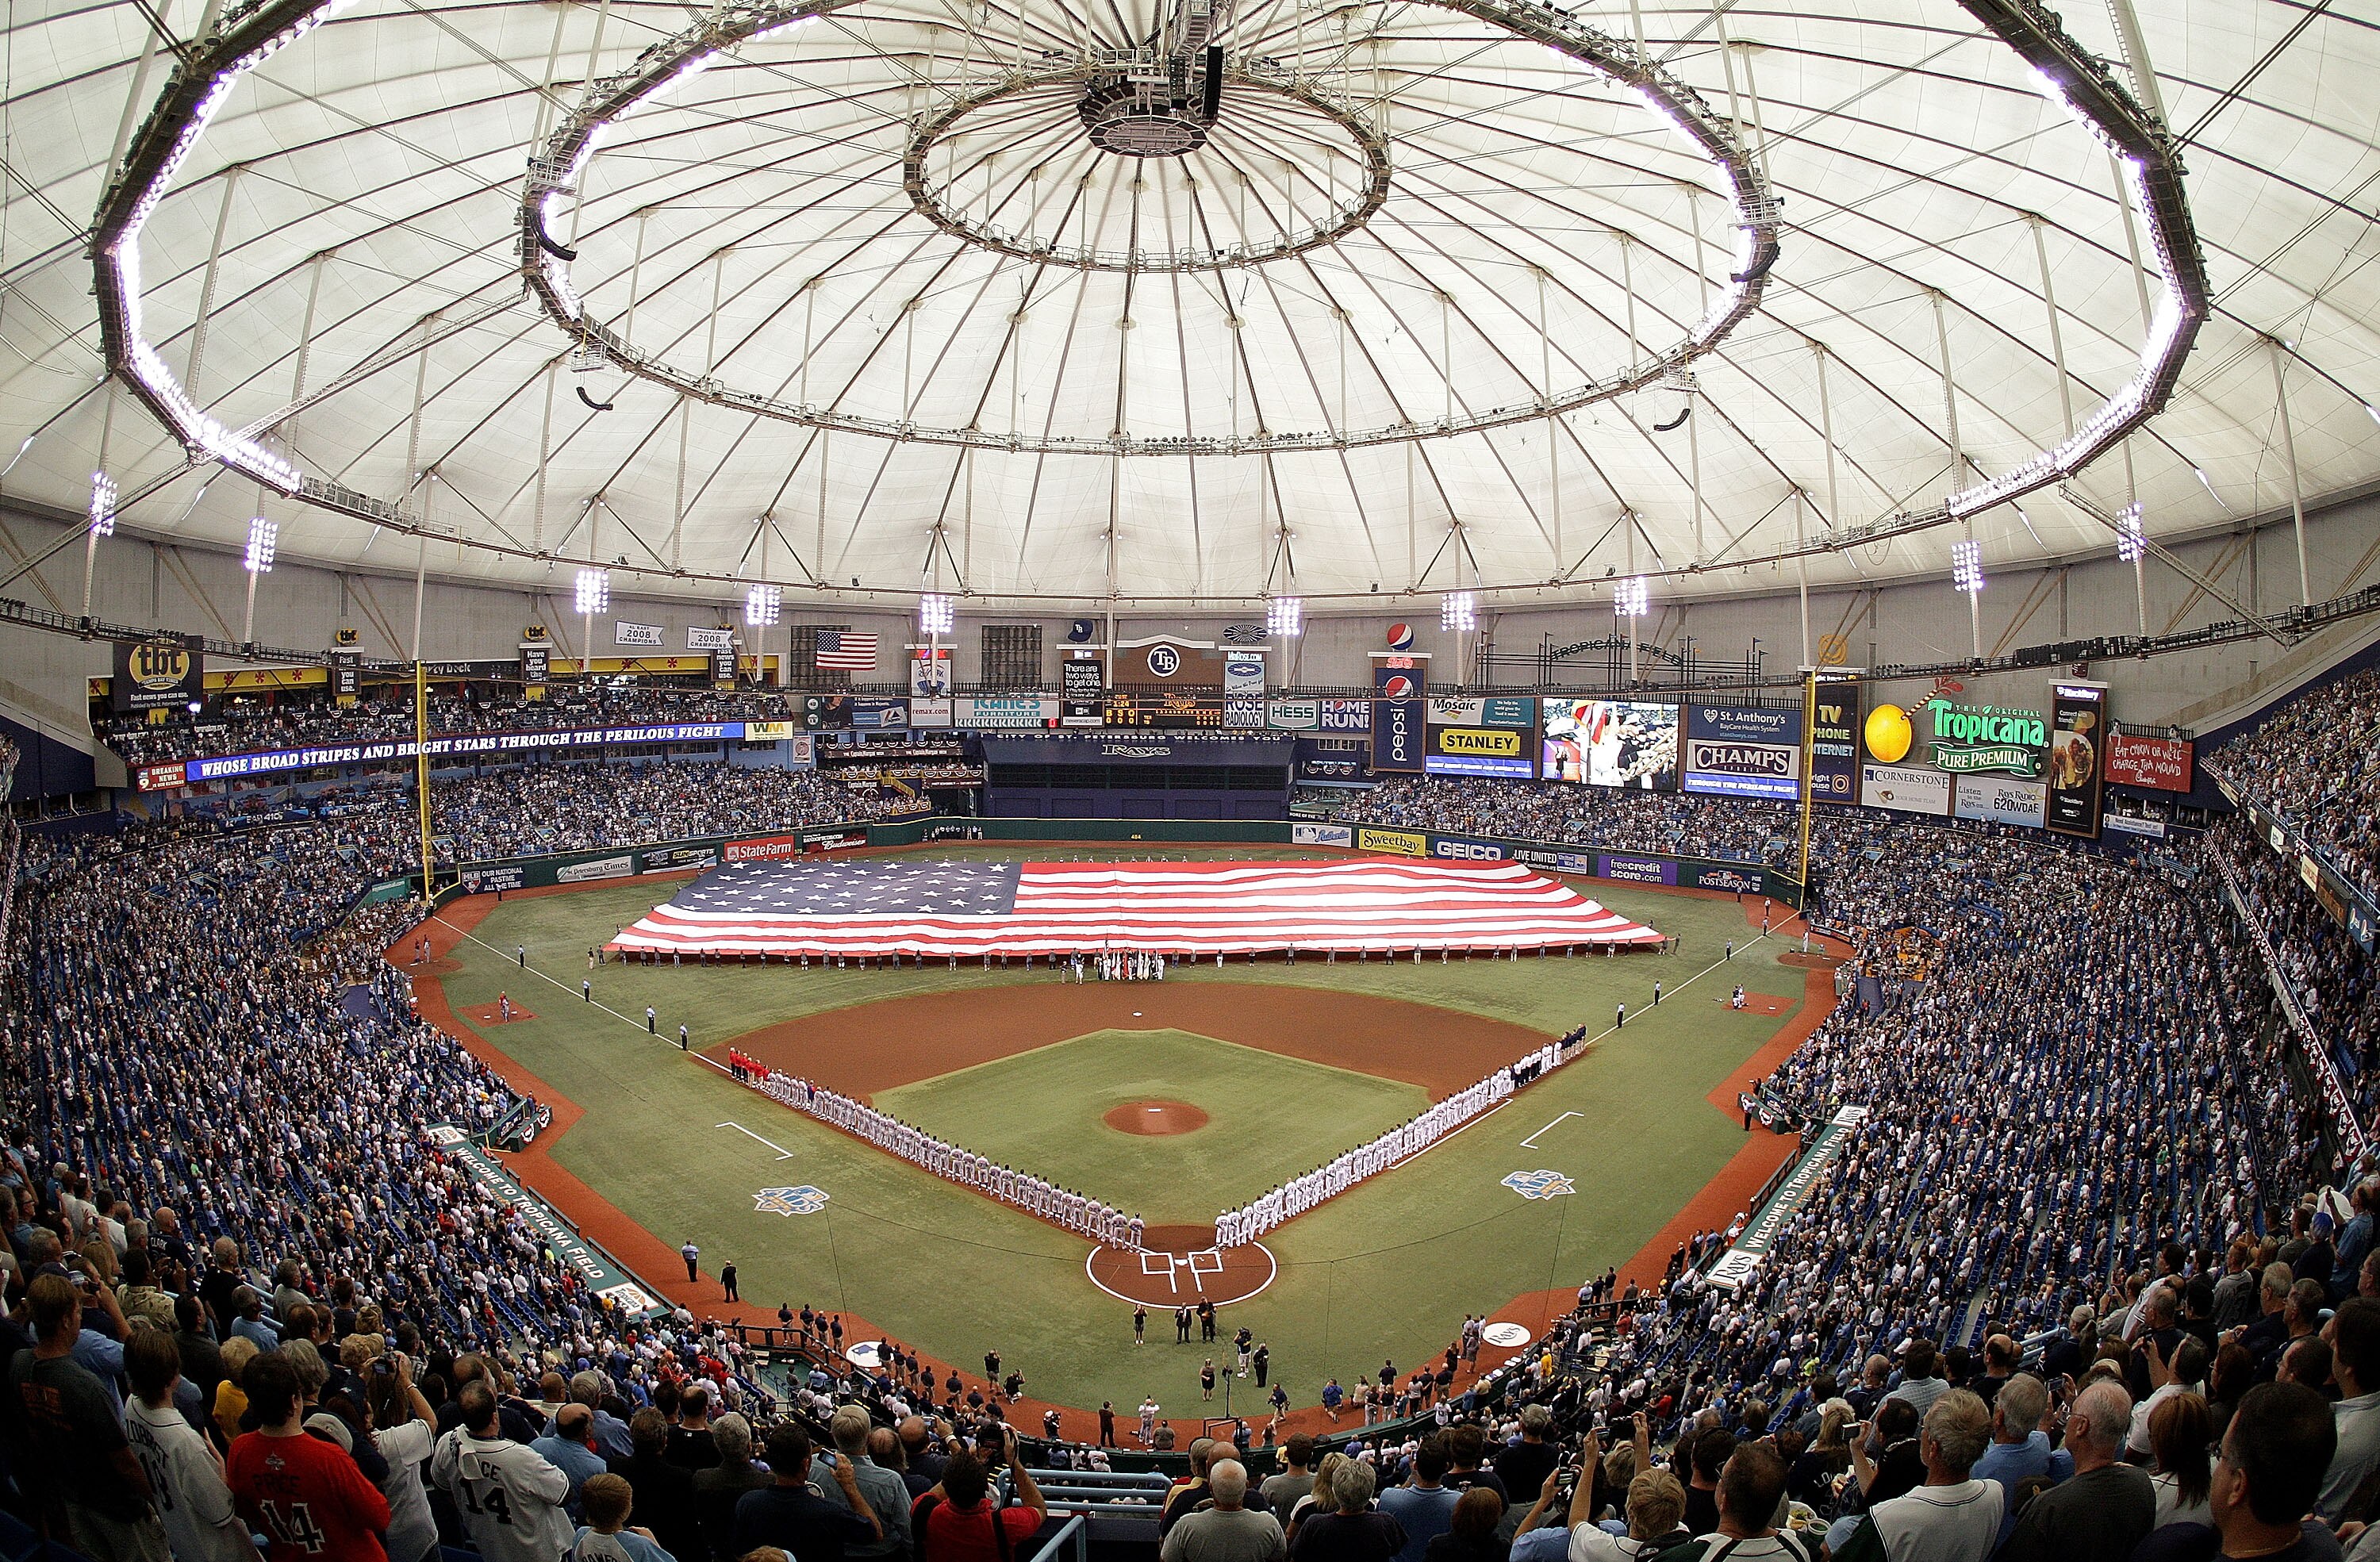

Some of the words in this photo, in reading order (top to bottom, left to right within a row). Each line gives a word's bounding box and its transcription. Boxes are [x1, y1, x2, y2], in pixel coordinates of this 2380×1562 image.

[619, 636, 657, 645] CHAMPIONS
[627, 630, 651, 639] 2008
[138, 643, 182, 677] tbt
[1154, 651, 1174, 670] TB
[1064, 664, 1085, 673] There
[1073, 679, 1087, 689] get
[1081, 674, 1100, 682] ways
[1225, 693, 1264, 711] ROSE
[1432, 698, 1476, 711] Mosaic
[1226, 712, 1263, 727] RADIOLOGY
[1272, 706, 1315, 718] HESS
[1719, 711, 1733, 721] St.
[1735, 712, 1786, 725] Anthony's
[1818, 704, 1843, 723] TV
[1995, 707, 2040, 717] ORIGINAL
[753, 722, 785, 733] WM
[1322, 714, 1369, 728] RUN!
[1719, 723, 1741, 731] BayCare
[1927, 699, 2045, 746] Tropicana
[1390, 708, 1408, 762] pepsi
[1446, 735, 1514, 750] STANLEY
[202, 758, 248, 777] WHOSE
[250, 752, 299, 772] BROAD
[301, 747, 359, 766] STRIPES
[362, 744, 394, 760] AND
[396, 739, 452, 757] BRIGHT
[453, 736, 497, 752] STARS
[499, 732, 571, 749] THROUGH
[573, 731, 602, 743] THE
[605, 727, 674, 743] PERILOUS
[677, 725, 724, 739] FIGHT
[1937, 749, 1969, 768] PURE
[1970, 750, 2028, 768] PREMIUM
[2114, 746, 2129, 758] EAT
[2152, 746, 2162, 757] OR
[1696, 746, 1788, 773] CHAMPS
[151, 765, 184, 776] BREAKING
[2112, 758, 2139, 771] CHARGE
[2155, 762, 2182, 777] MOUND
[139, 777, 150, 789] 9
[158, 773, 177, 783] NEWS
[1875, 769, 1948, 789] CORNERSTONE
[1958, 785, 1982, 796] Listen
[821, 839, 866, 850] Budweiser
[1364, 830, 1420, 854] Sweetbay
[1437, 841, 1502, 861] GEICO
[1514, 849, 1530, 861] LIVE
[1531, 850, 1557, 864] UNITED
[495, 866, 524, 876] NATIONAL
[573, 864, 603, 875] Petersburg
[604, 860, 629, 870] Times
[490, 874, 516, 883] PASTIME
[1610, 869, 1662, 884] score.com
[1699, 875, 1751, 890] POSTSEASON
[1745, 1200, 1787, 1249] WELCOME
[1780, 1190, 1797, 1202] TO
[1791, 1147, 1834, 1193] TROPICANA
[1823, 1126, 1850, 1149] FIELD
[455, 1146, 505, 1184] WELCOME
[499, 1182, 518, 1195] TO
[512, 1194, 574, 1249] TROPICANA
[566, 1241, 606, 1280] FIELD
[459, 1478, 513, 1526] 14
[259, 1499, 326, 1554] 14
